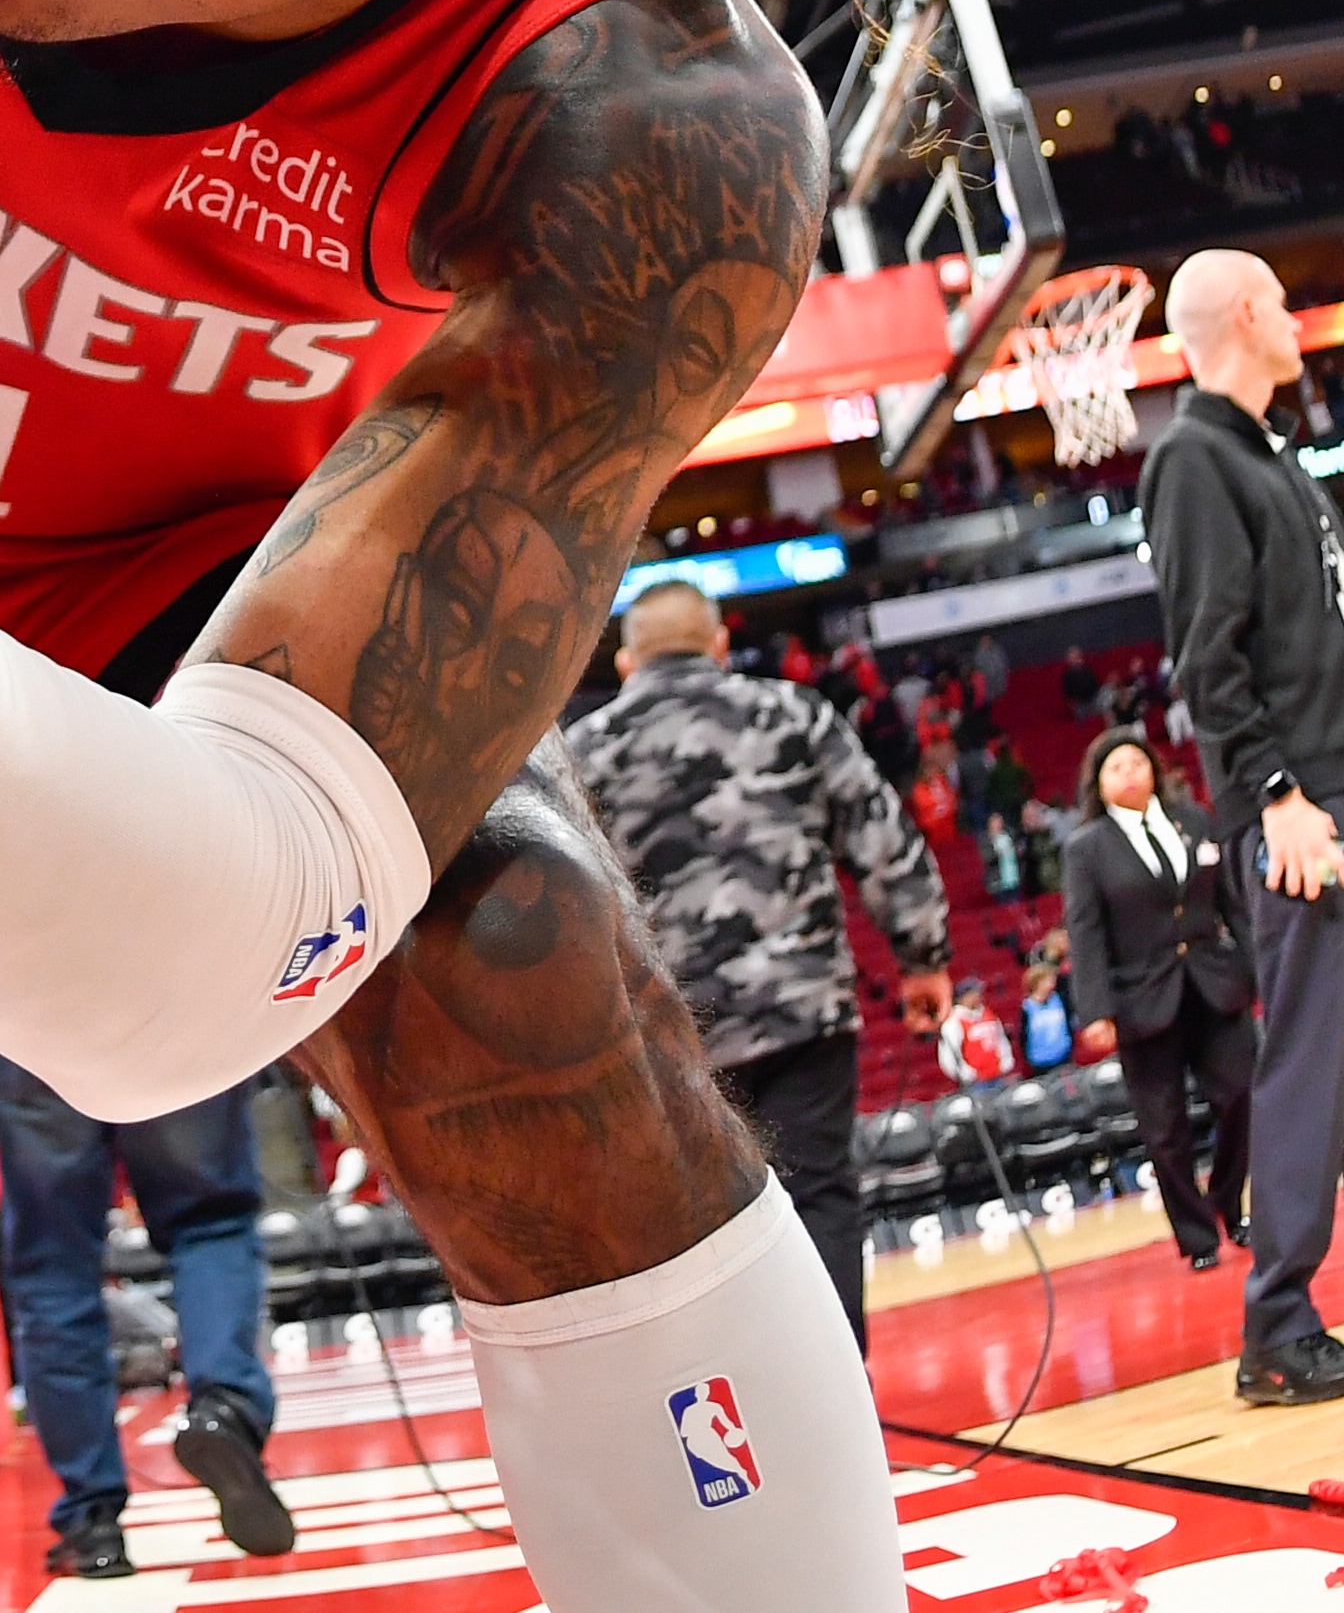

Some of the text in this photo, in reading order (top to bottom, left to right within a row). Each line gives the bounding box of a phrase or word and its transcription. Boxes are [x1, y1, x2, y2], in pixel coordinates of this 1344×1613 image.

[163, 164, 350, 273] karma
[285, 944, 314, 980] NBA
[703, 1475, 741, 1503] NBA
